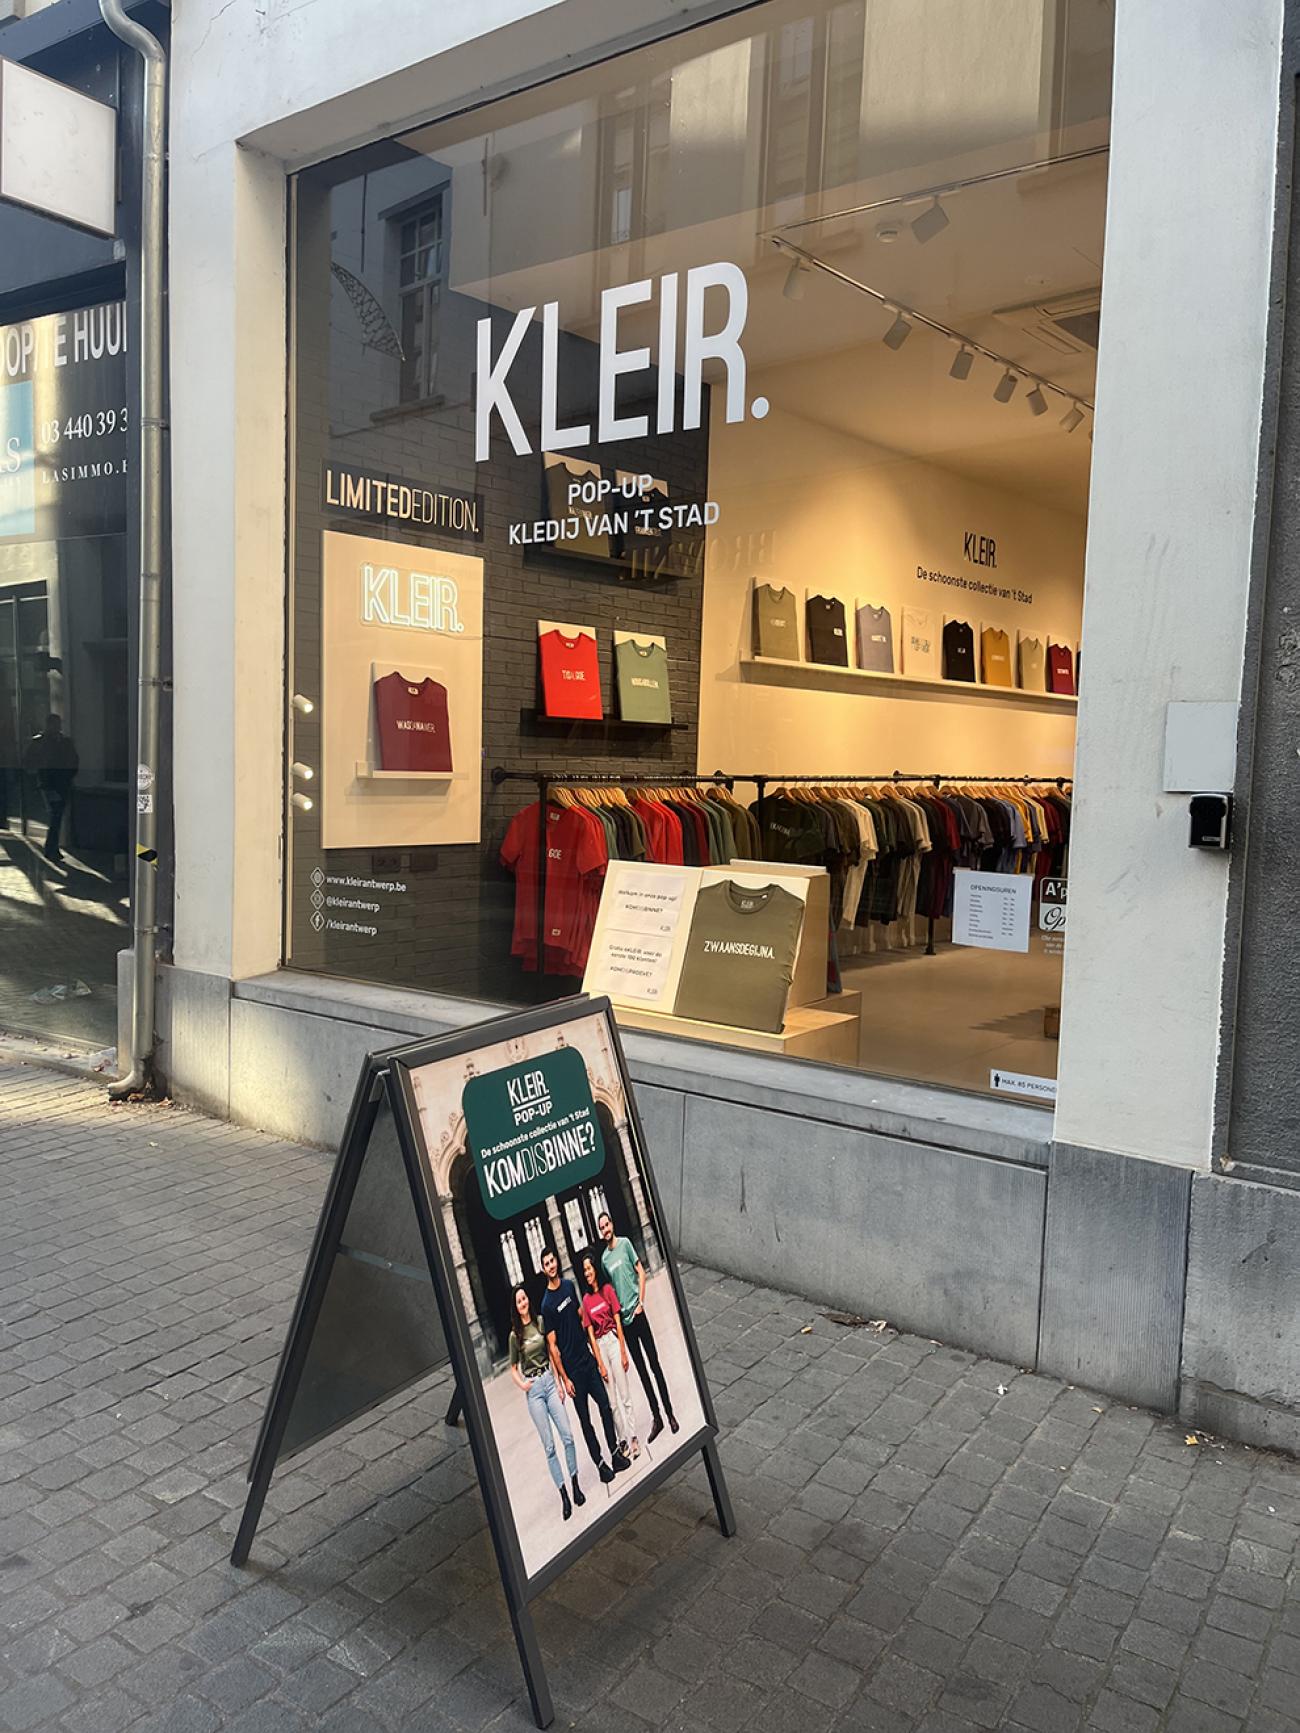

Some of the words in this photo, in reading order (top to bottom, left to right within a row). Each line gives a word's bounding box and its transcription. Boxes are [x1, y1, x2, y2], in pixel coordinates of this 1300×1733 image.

[475, 261, 769, 462] KLEIR.
[64, 413, 93, 440] 440
[96, 409, 117, 436] 39
[326, 469, 479, 533] LIMITEDEDITION.
[568, 474, 653, 506] POP-UP
[508, 517, 580, 545] KLEDIJ
[585, 511, 629, 537] VAN
[634, 509, 654, 531] 'T
[658, 502, 720, 530] STAD
[363, 564, 465, 633] KLEIR.
[916, 566, 927, 579] De
[929, 571, 967, 589] schoonste
[968, 580, 998, 596] collectie
[998, 588, 1011, 599] van
[1018, 590, 1033, 604] Stad
[326, 876, 407, 893] www.kleirantwerp.be
[326, 895, 380, 912] @kleirantwerp
[326, 919, 378, 936] /kleirantwerp
[481, 1147, 491, 1159] De
[492, 1134, 529, 1154] schoonste
[529, 1121, 557, 1139] collectie
[556, 1116, 569, 1127] van
[575, 1107, 590, 1119] Stad
[515, 1102, 553, 1126] POP-UP
[483, 1121, 596, 1198] KOMDISBINNE?
